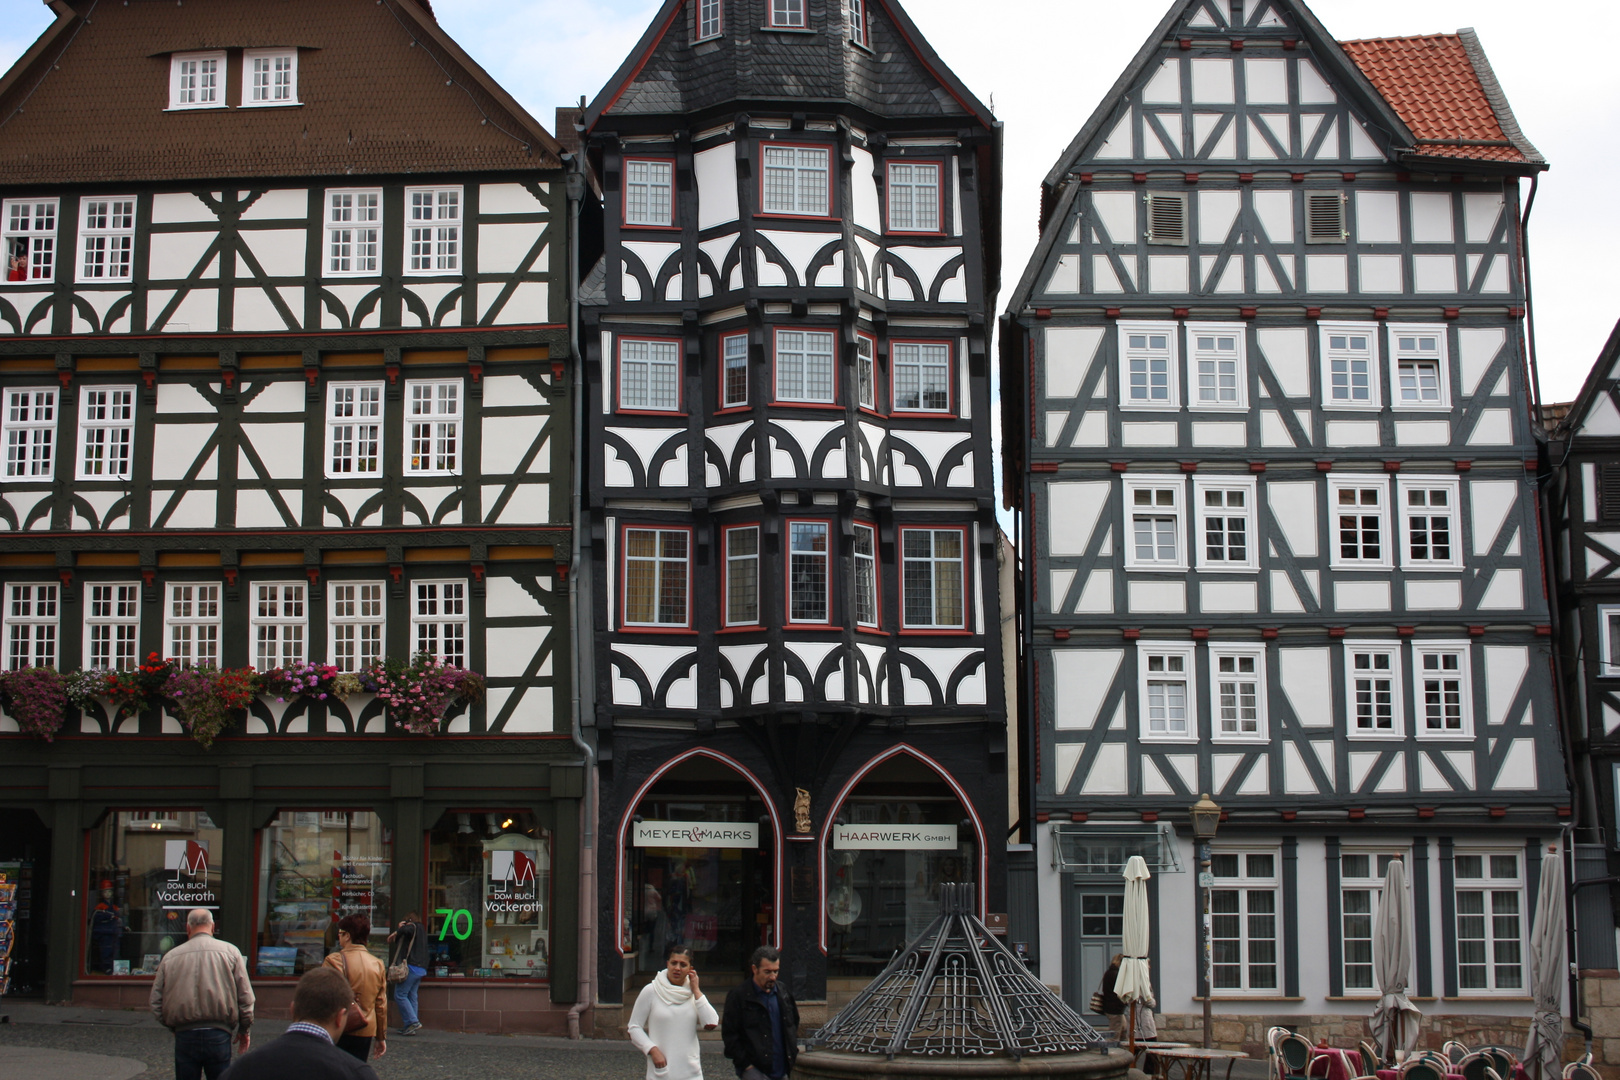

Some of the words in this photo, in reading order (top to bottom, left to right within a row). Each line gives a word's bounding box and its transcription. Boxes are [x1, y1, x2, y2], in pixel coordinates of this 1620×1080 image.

[839, 832, 921, 842] HAARWERK
[166, 882, 185, 890] DOM
[186, 882, 208, 890] BUCH
[156, 890, 215, 902] Vockeroth
[494, 892, 513, 900] DOM
[514, 892, 535, 900] BUCH
[484, 900, 544, 912] Vockeroth
[435, 908, 473, 942] 70
